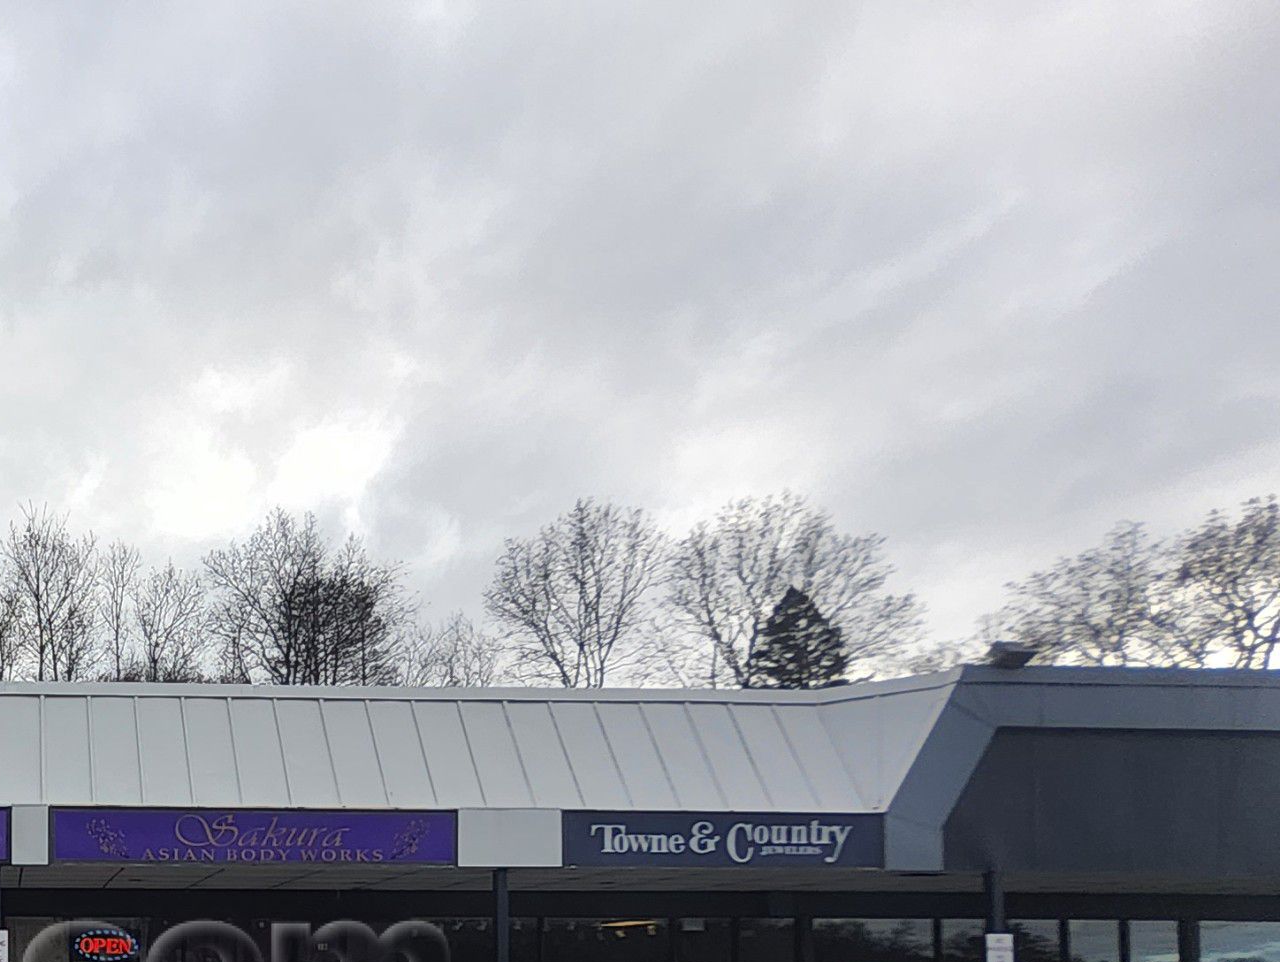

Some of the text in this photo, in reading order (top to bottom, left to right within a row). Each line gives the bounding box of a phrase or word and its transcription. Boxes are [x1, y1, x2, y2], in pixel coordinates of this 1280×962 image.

[175, 813, 352, 848] Sakura
[589, 819, 854, 864] Towne & Country
[143, 848, 384, 862] ASIAN BODY WORKS
[80, 937, 135, 954] OPEN
